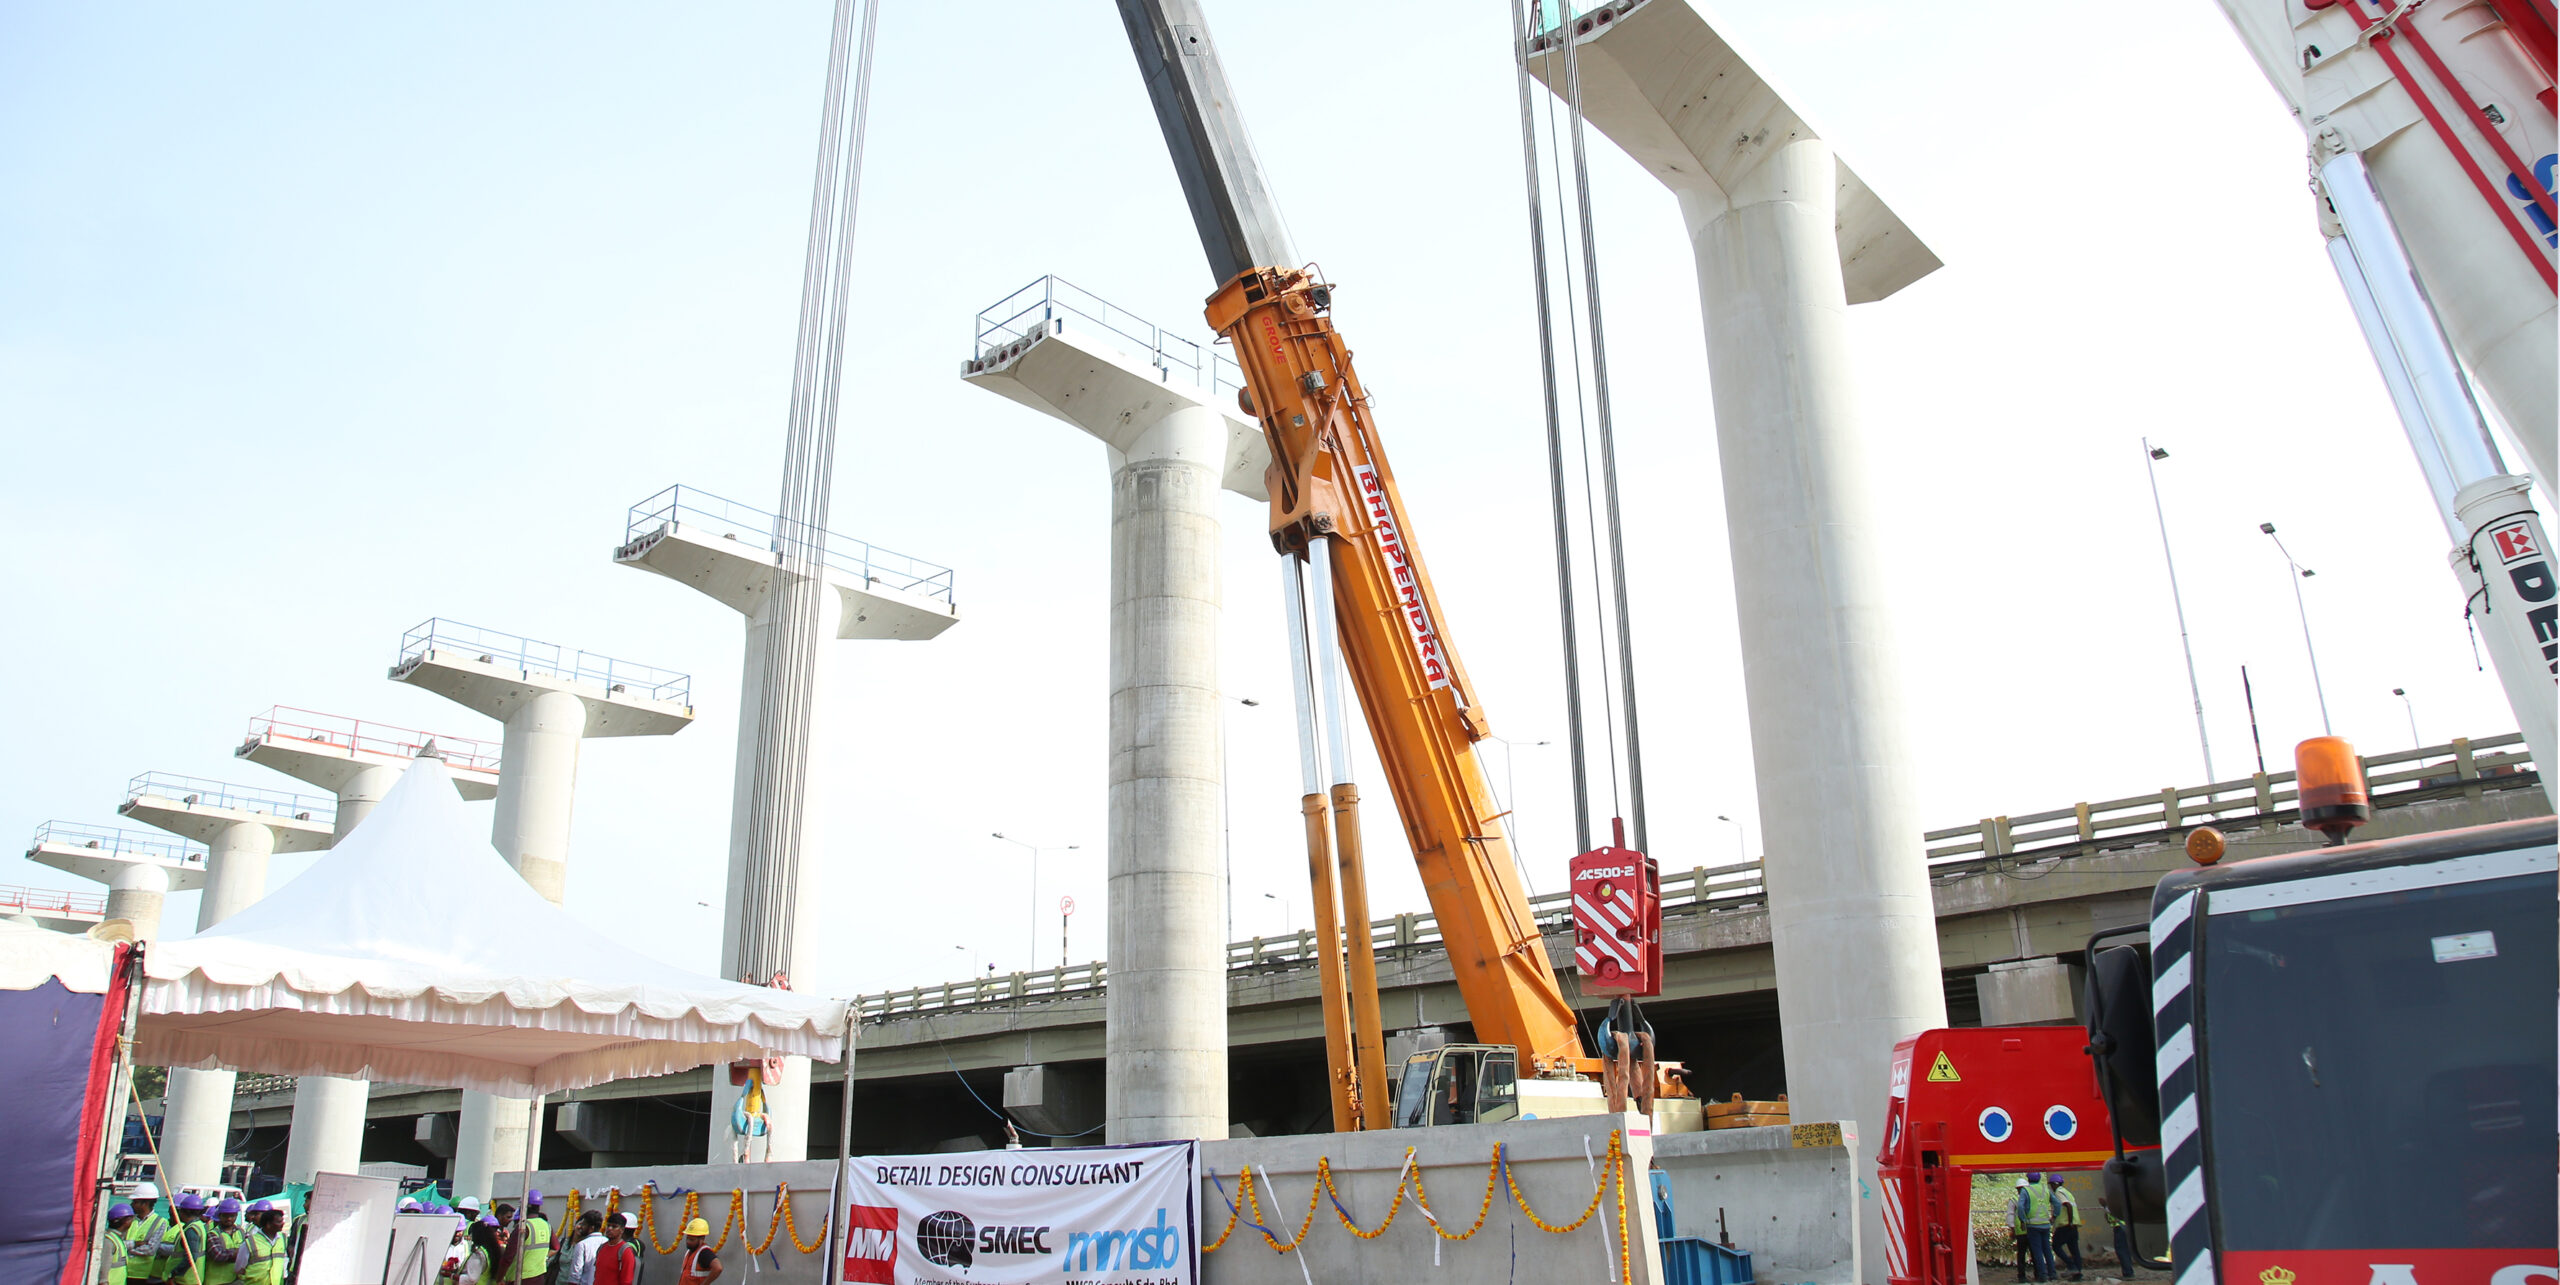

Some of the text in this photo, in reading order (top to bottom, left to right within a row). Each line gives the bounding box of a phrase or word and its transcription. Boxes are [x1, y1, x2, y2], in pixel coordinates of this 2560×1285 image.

[1262, 316, 1287, 365] GROVE
[1359, 470, 1445, 683] BHUPENDRA
[2508, 561, 2558, 688] DE
[1576, 865, 1635, 881] AC500-2
[876, 1161, 1144, 1187] DETAIL DESIGN CONSULTANT
[847, 1226, 895, 1262] MM
[979, 1225, 1053, 1255] SMEC
[1063, 1207, 1180, 1273] mmsb
